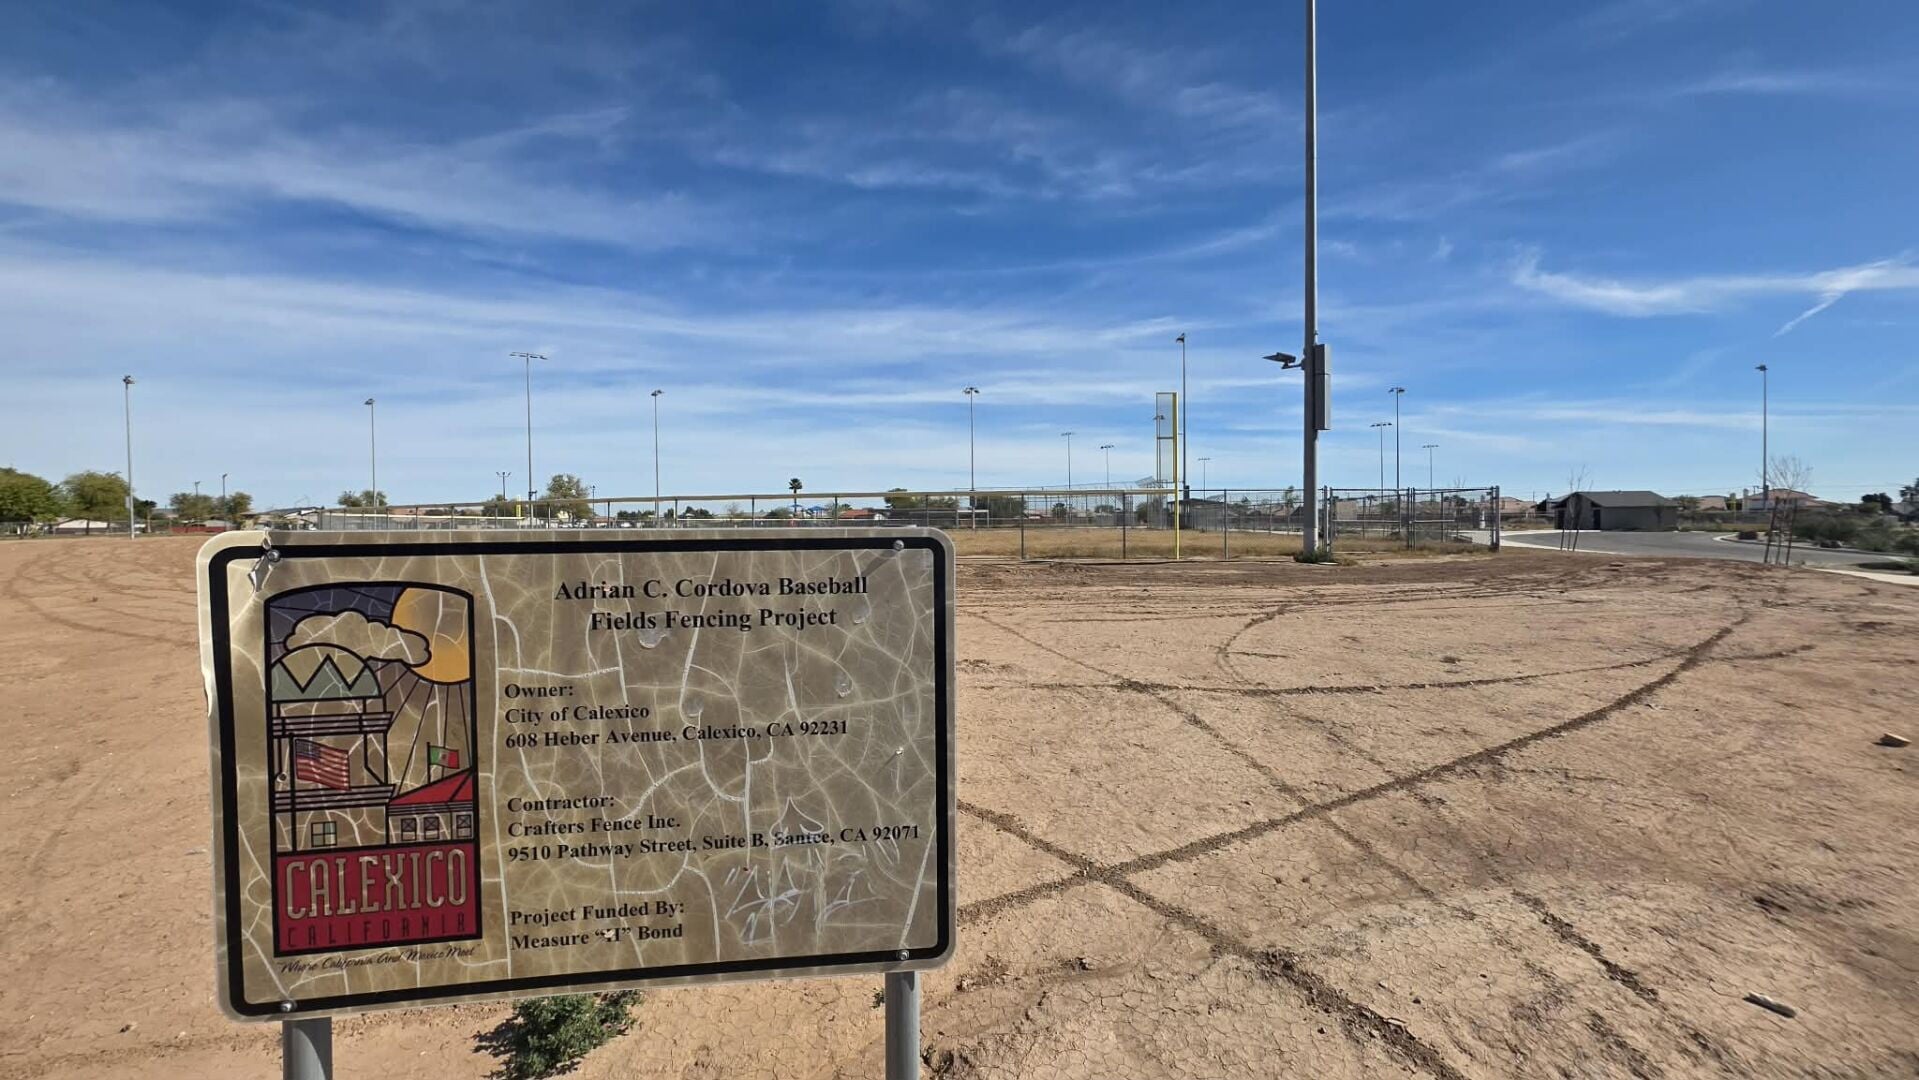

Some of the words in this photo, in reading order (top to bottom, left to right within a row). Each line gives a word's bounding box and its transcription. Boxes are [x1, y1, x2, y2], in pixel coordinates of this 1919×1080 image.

[555, 581, 635, 600] Adrian
[643, 579, 668, 598] C.
[675, 578, 770, 597] Cordova
[777, 576, 868, 595] Baseball
[591, 612, 657, 630] Fields
[664, 609, 752, 632] Fencing
[759, 608, 838, 630] Project
[504, 684, 574, 699] Owner:
[505, 708, 544, 726] City
[550, 707, 569, 722] of
[573, 704, 650, 720] Calexico
[505, 732, 538, 748] 608
[544, 731, 600, 746] Heber
[605, 728, 677, 744] Avenue,
[682, 724, 761, 741] Calexico,
[766, 722, 794, 737] CA
[800, 720, 848, 735] 92231
[507, 795, 615, 812] Contractor:
[508, 819, 585, 837] Crafters
[591, 815, 642, 833] Fence
[648, 814, 681, 830] Inc.
[508, 846, 551, 862] 9510
[557, 841, 634, 859] Pathway
[639, 838, 697, 854] Street,
[702, 834, 746, 850] Suite
[752, 833, 769, 848] B,
[840, 828, 867, 843] CA
[873, 825, 919, 841] 92071
[286, 849, 467, 920] CALEXICO
[510, 909, 576, 927] Project
[582, 902, 649, 921] Funded
[656, 901, 685, 917] By:
[287, 911, 466, 948] CALIFORNIA
[511, 932, 590, 950] Measure
[638, 924, 683, 940] Bond
